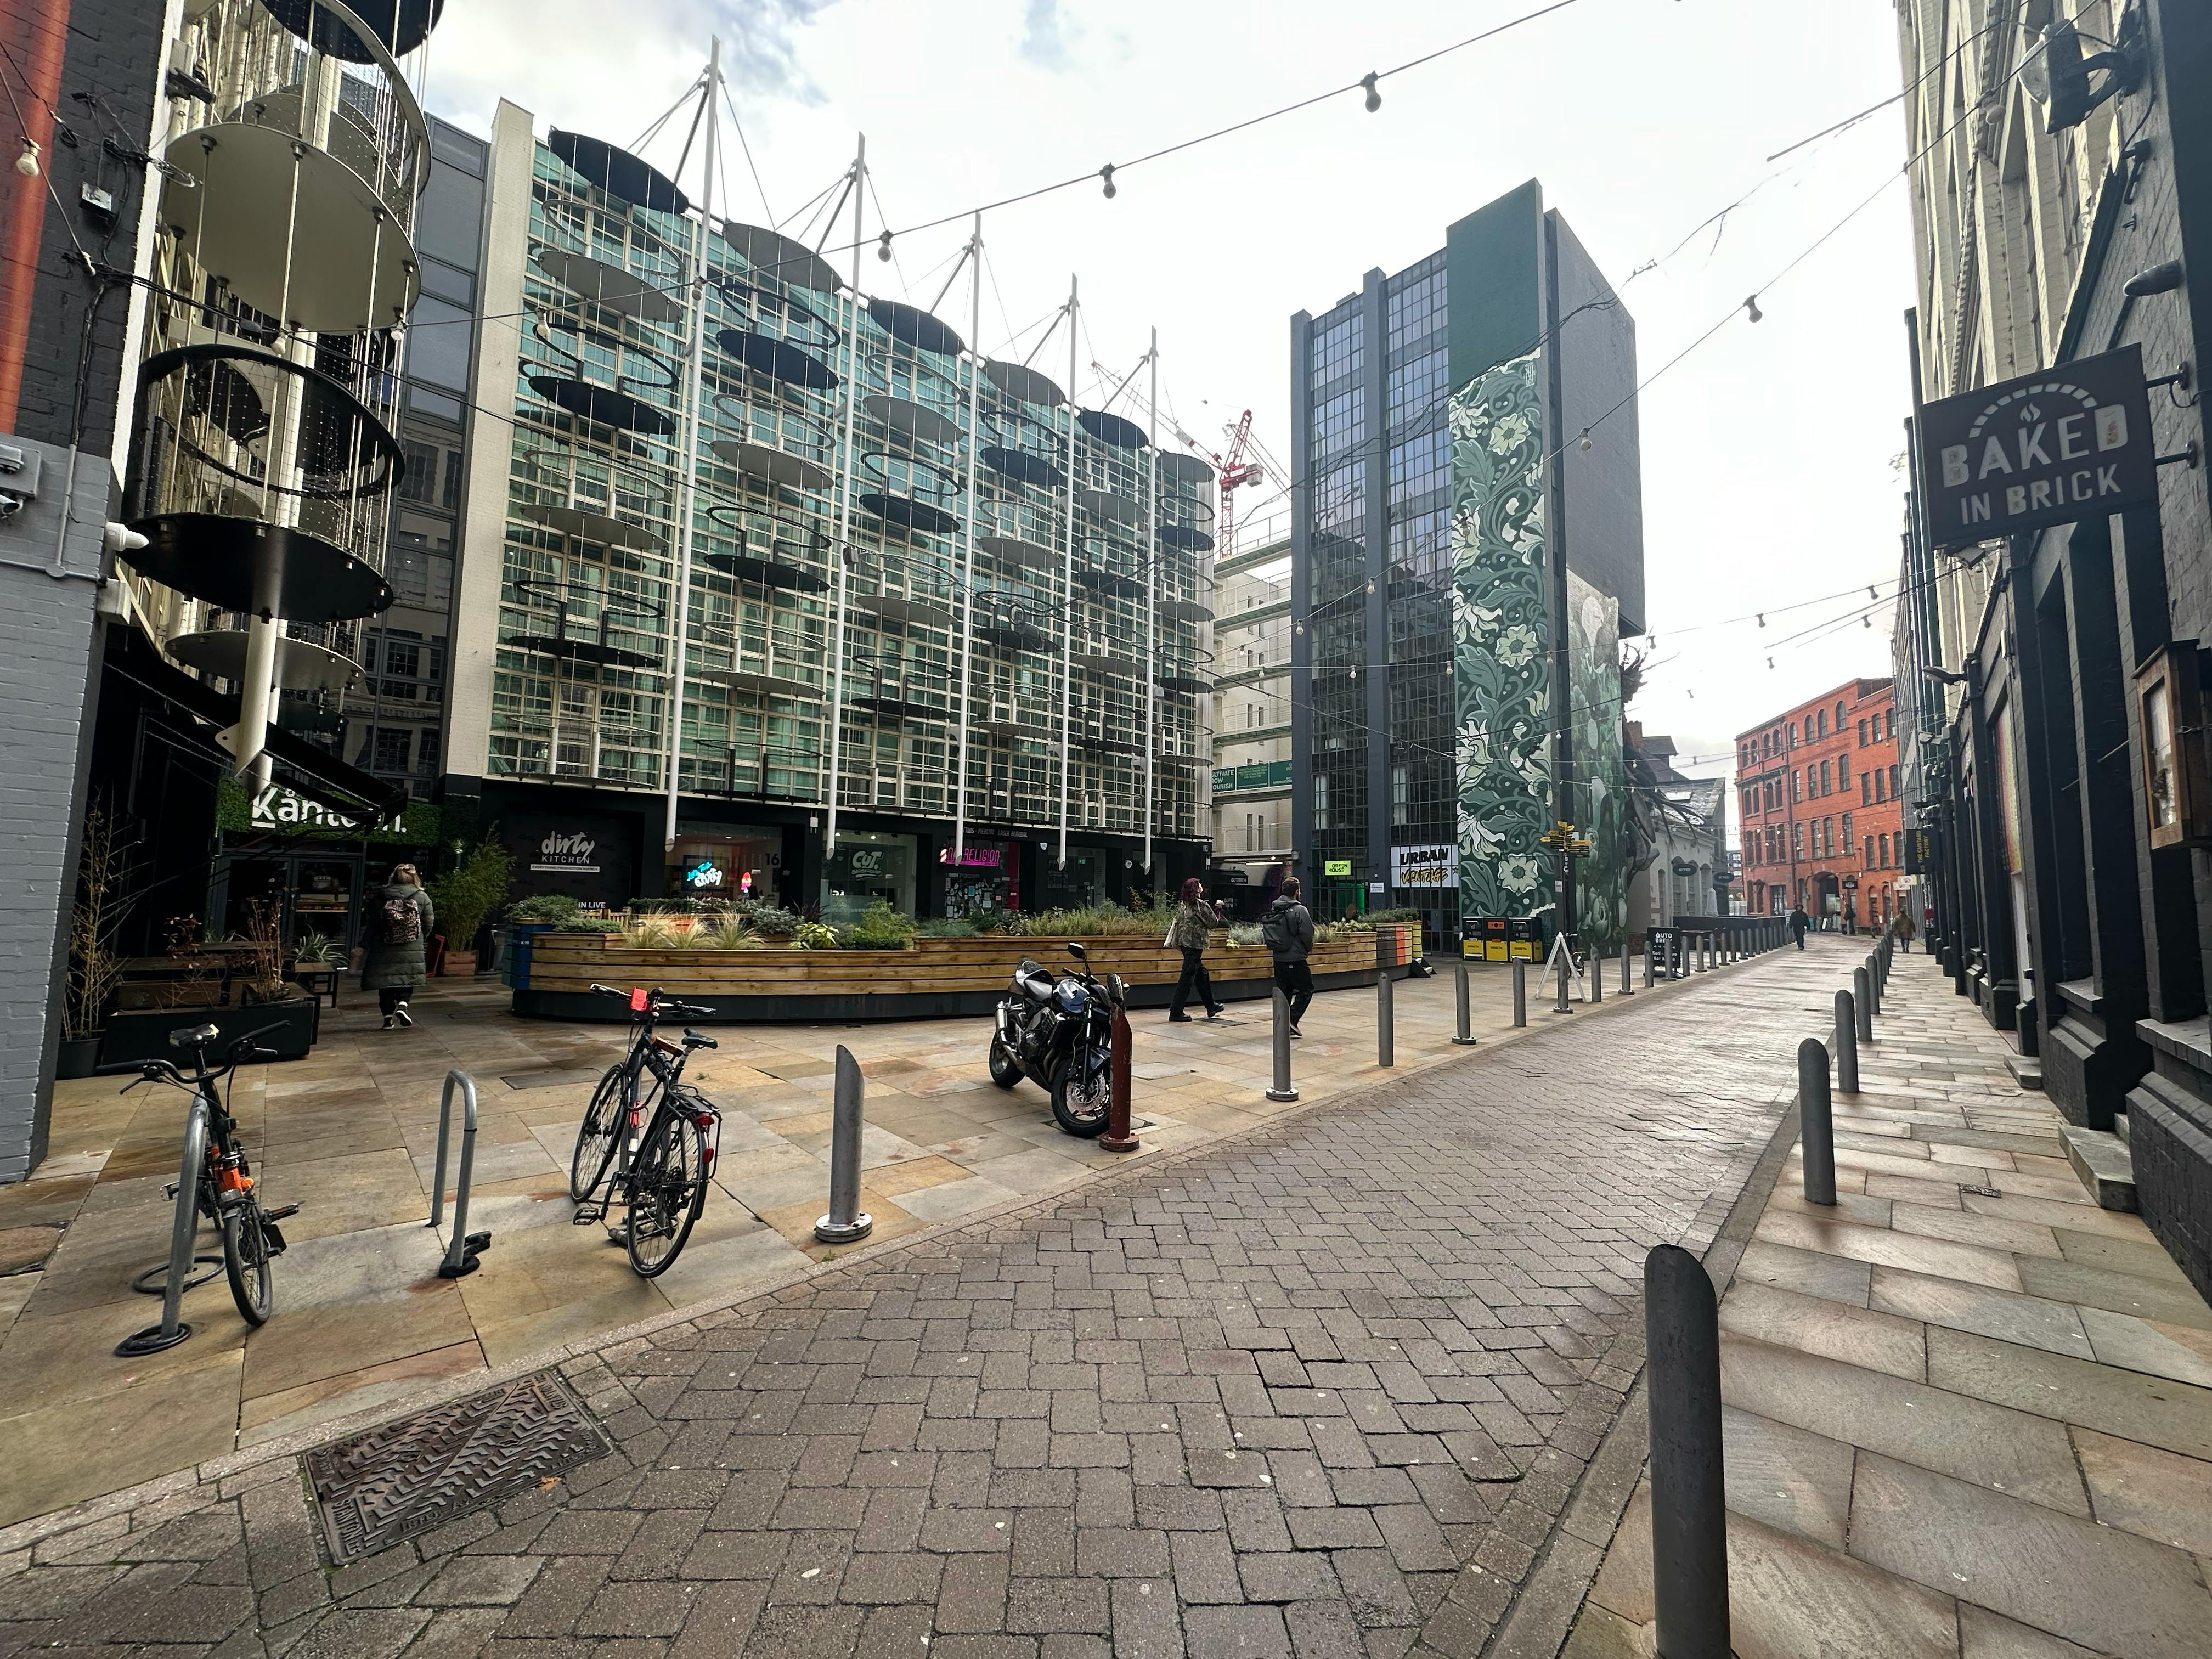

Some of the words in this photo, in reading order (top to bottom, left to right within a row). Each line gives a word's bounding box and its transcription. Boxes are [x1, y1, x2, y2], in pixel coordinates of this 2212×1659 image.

[1940, 404, 2128, 488] BAKED
[1960, 492, 1990, 524] IN
[2006, 464, 2121, 516] BRICK
[251, 787, 407, 833] Kåntn.
[541, 831, 595, 862] dirty
[963, 848, 1000, 863] RELIGION
[1400, 848, 1449, 865] URBAN
[541, 855, 590, 864] KITCHEN
[765, 853, 780, 866] 16
[852, 850, 883, 870] CUT.
[331, 1498, 364, 1542] STANTON
